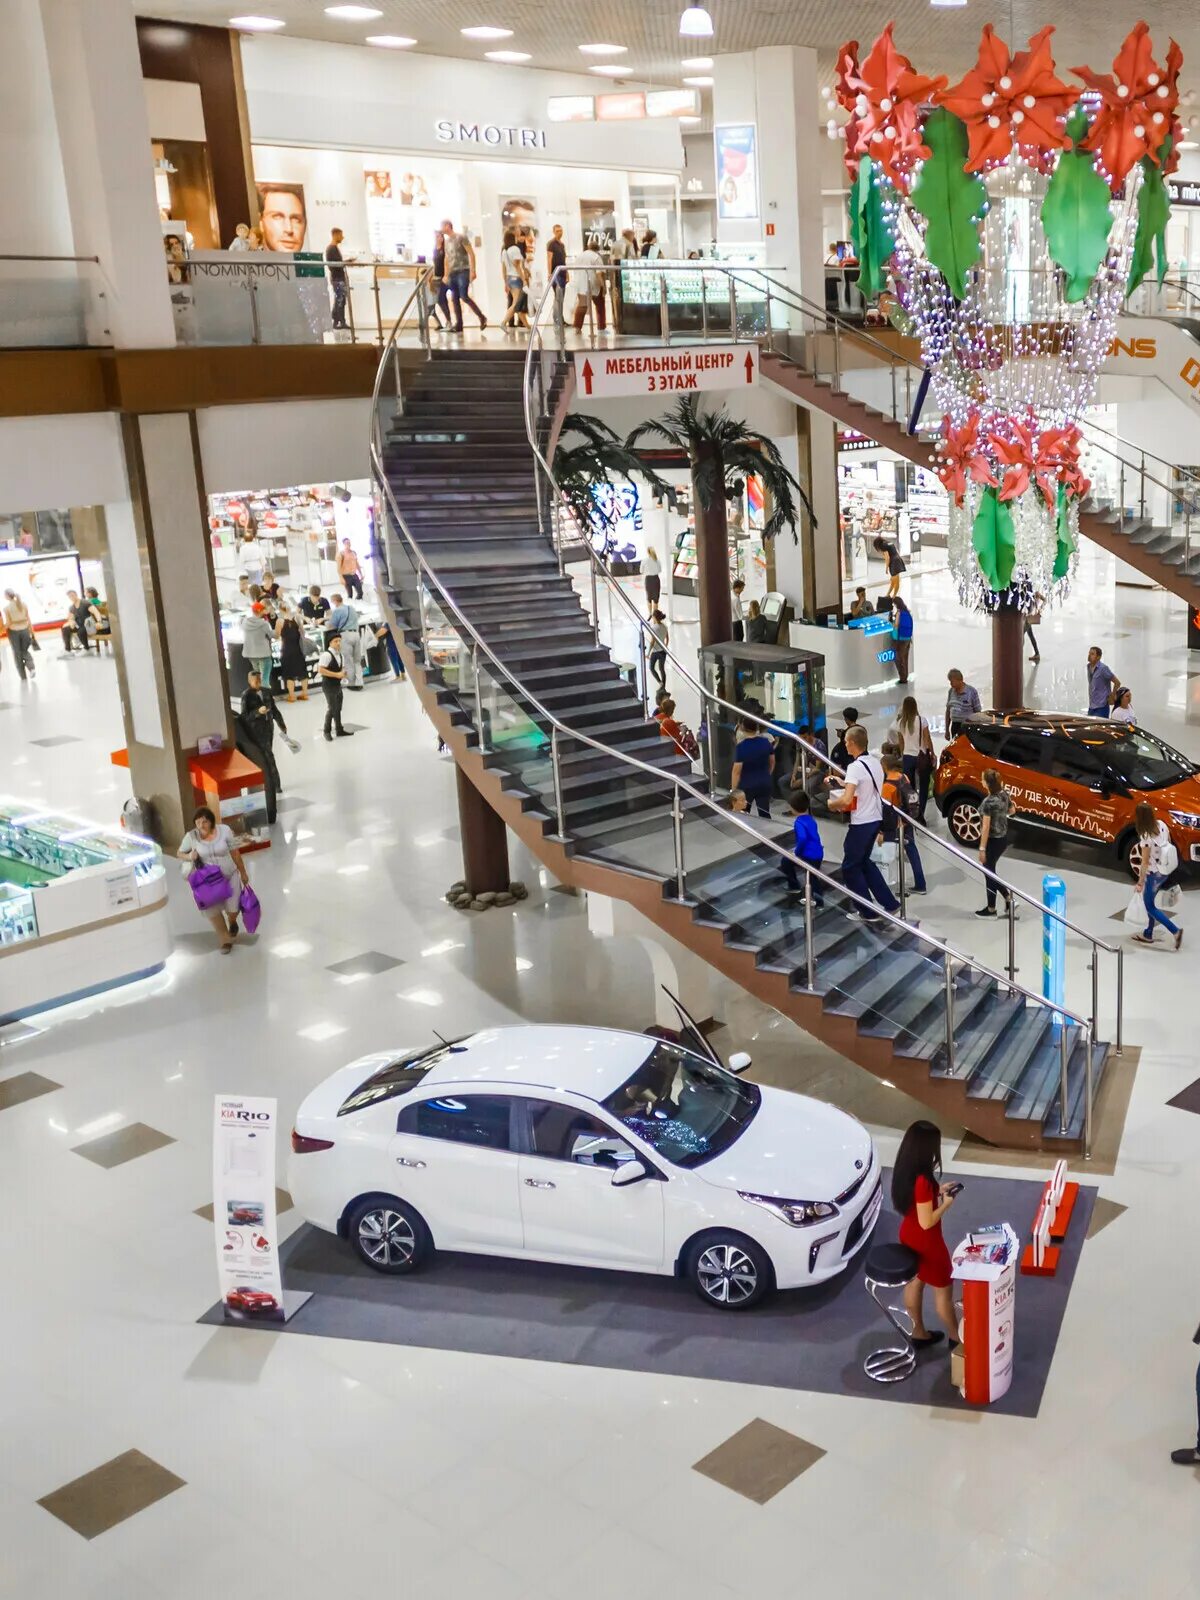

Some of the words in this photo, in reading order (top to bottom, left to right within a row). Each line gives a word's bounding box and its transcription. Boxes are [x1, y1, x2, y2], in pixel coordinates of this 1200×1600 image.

[437, 121, 547, 148] SMOTRI
[193, 263, 291, 281] NOMINATION
[605, 351, 692, 374] МЕБЕЛЬНЫЙ
[695, 353, 734, 372] ЦЕНТР
[648, 376, 656, 391] 3
[660, 374, 698, 390] ЭТАЖ
[1004, 783, 1023, 796] ЕДУ
[1025, 789, 1042, 803] ГДЕ
[1044, 795, 1070, 810] ХОЧУ
[221, 1110, 235, 1119] KIA
[237, 1111, 270, 1121] RIO
[994, 1293, 1007, 1306] KIA
